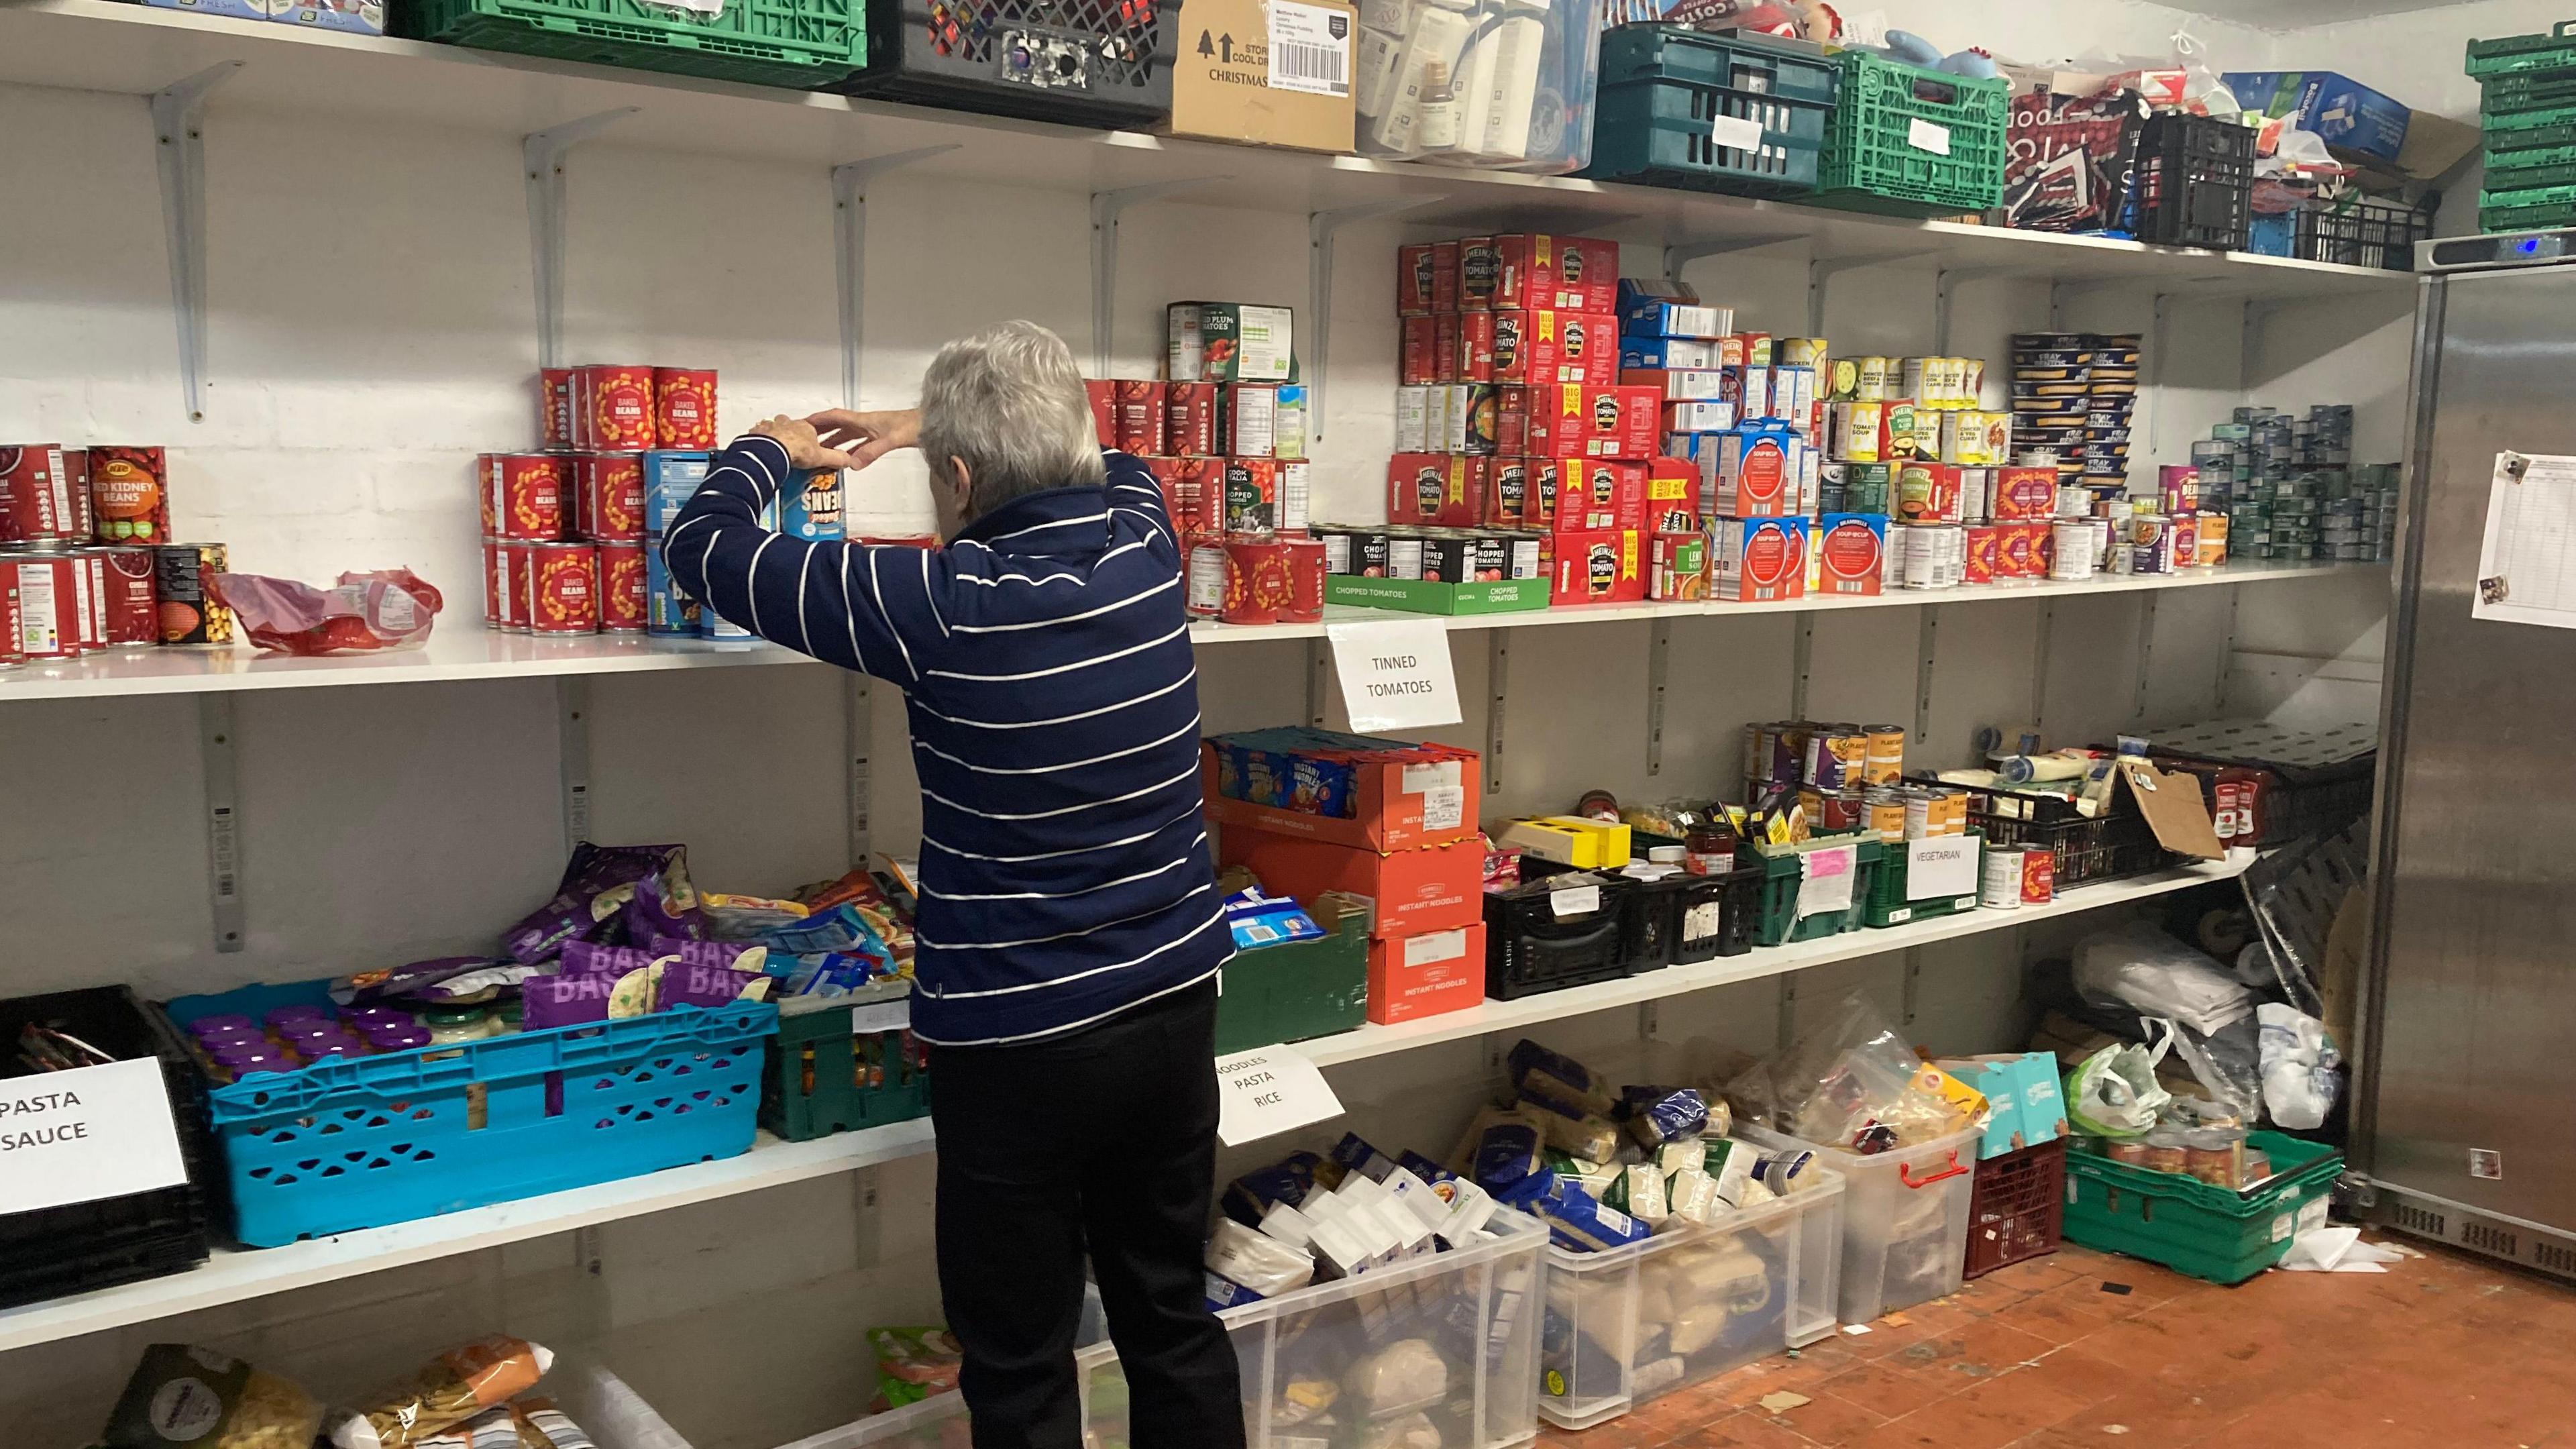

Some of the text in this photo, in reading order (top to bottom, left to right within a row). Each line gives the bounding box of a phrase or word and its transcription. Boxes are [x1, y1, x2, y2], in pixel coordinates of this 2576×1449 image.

[1246, 44, 1269, 55] STOR
[1232, 53, 1269, 66] COOL DR
[1209, 68, 1267, 88] CHRISTMAS
[1468, 247, 1493, 259] HEINZ
[1540, 313, 1552, 323] BIG
[1565, 388, 1579, 396] BIG
[615, 407, 641, 415] BEANS
[672, 409, 698, 418] BEANS
[1568, 462, 1580, 471] BIG
[1422, 470, 1440, 479] HEINZ
[1505, 469, 1525, 479] HEIN
[111, 482, 153, 492] KIDNEY
[1419, 485, 1440, 494] TOMATO
[1501, 486, 1523, 495] TOMA
[103, 492, 140, 502] BEANS
[1625, 535, 1636, 544] BIG
[1364, 545, 1385, 553] CHOP
[1594, 546, 1611, 555] HEINZ
[1591, 563, 1613, 572] TOMATO
[1336, 586, 1407, 598] CHOPPED TOMATOES
[1490, 586, 1518, 594] CHOPPED
[1488, 594, 1519, 602] TOMATOES
[1372, 655, 1417, 671] TINNED
[1366, 680, 1432, 698] TOMATOES
[1403, 816, 1422, 824] INSTA
[1917, 850, 1960, 862] VEGETARIAN
[1398, 896, 1463, 912] INSTANT NOODLES
[1405, 977, 1468, 997] INSTANT NOODLES
[1234, 1071, 1275, 1090] PASTA
[0, 1091, 81, 1118] PASTA
[1253, 1091, 1283, 1108] RICE
[1, 1122, 88, 1151] SAUCE
